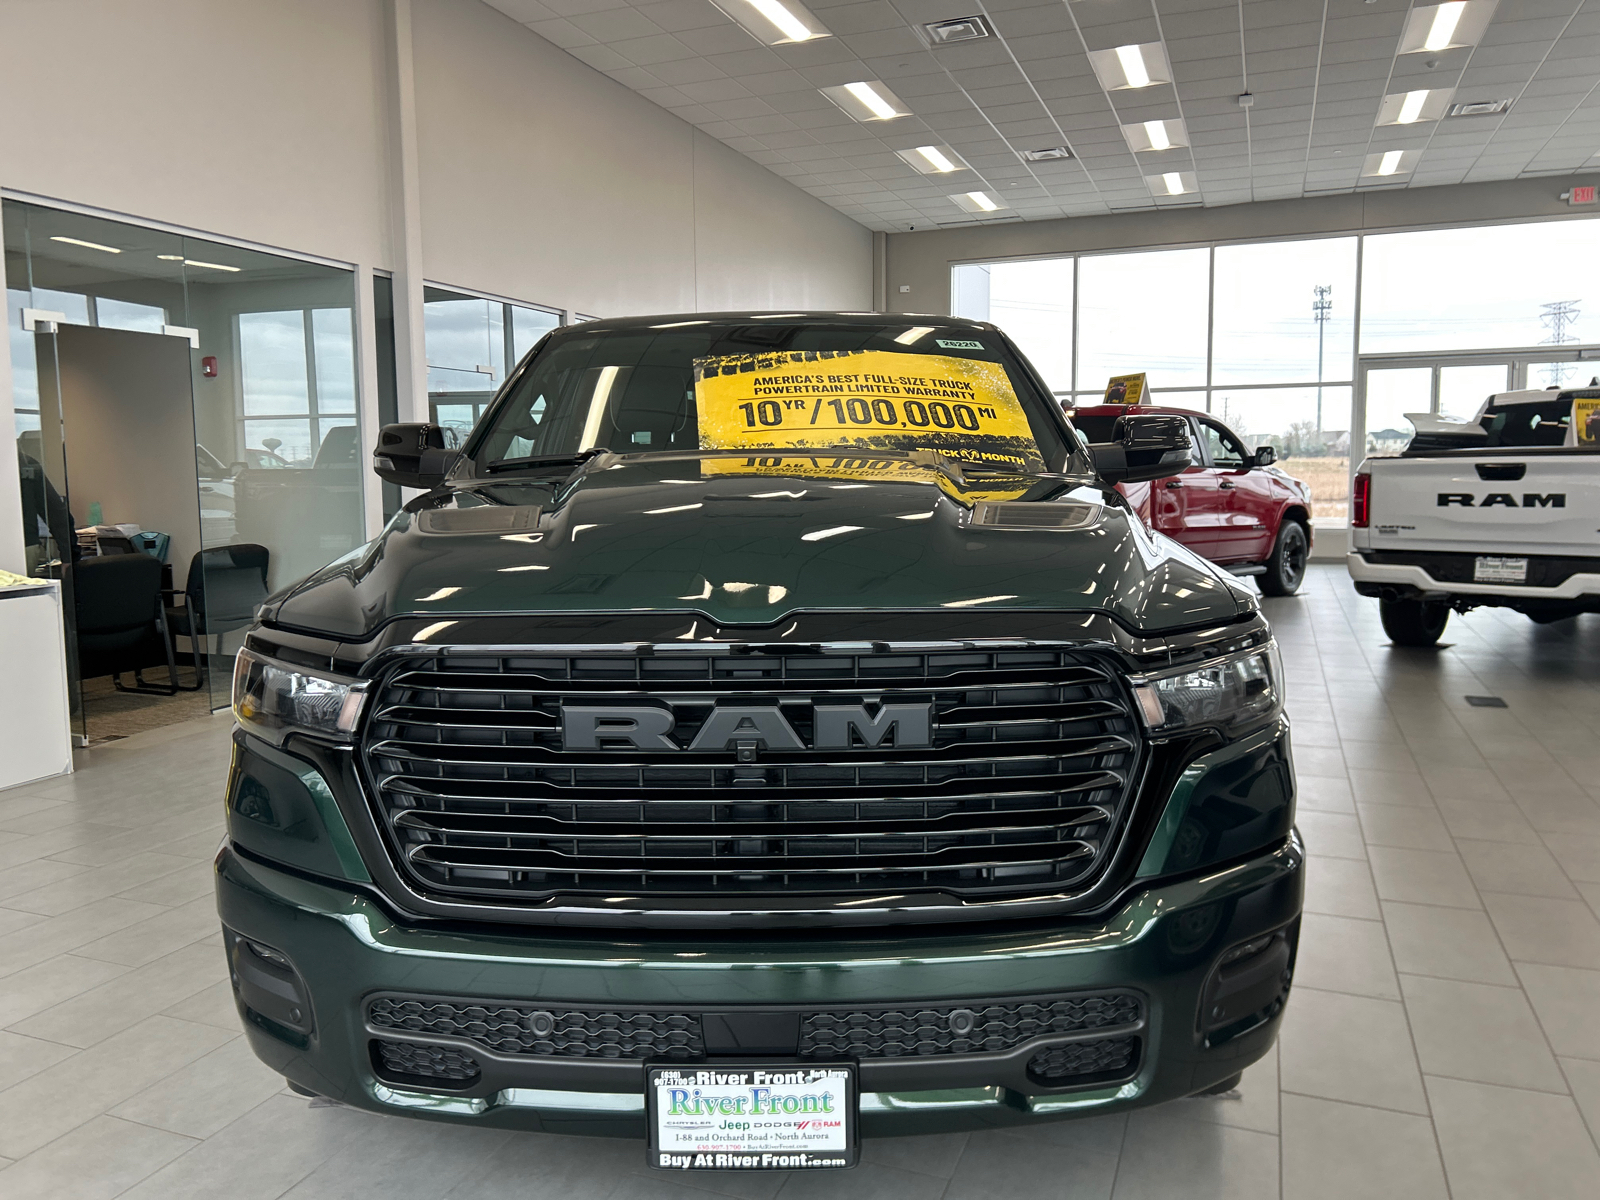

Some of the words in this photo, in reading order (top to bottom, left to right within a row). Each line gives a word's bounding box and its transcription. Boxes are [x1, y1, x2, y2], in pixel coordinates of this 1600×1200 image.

[1574, 186, 1594, 202] EXIT
[753, 374, 824, 386] AMERICA'S
[828, 374, 860, 384] BEST
[864, 374, 928, 387] FULL-SIZE
[930, 378, 973, 391] TRUCK
[754, 385, 844, 395] POWERTRAIN
[847, 384, 900, 394] LIMITED
[903, 387, 975, 400] WARRANTY
[981, 453, 1025, 465] MONTH
[1437, 493, 1566, 508] RAM
[562, 702, 933, 751] RAM
[696, 1071, 748, 1085] River
[753, 1070, 805, 1085] Front
[667, 1088, 749, 1115] River
[749, 1087, 835, 1115] Front
[718, 1119, 751, 1131] Jeep
[823, 1120, 842, 1128] RAM
[675, 1133, 693, 1142] I-88
[694, 1133, 710, 1142] and
[711, 1133, 746, 1142] Orchard
[747, 1132, 769, 1141] Road
[774, 1132, 800, 1141] North
[800, 1132, 830, 1140] Aurora
[659, 1153, 691, 1169] Buy
[694, 1153, 714, 1167] At
[715, 1153, 760, 1167] River
